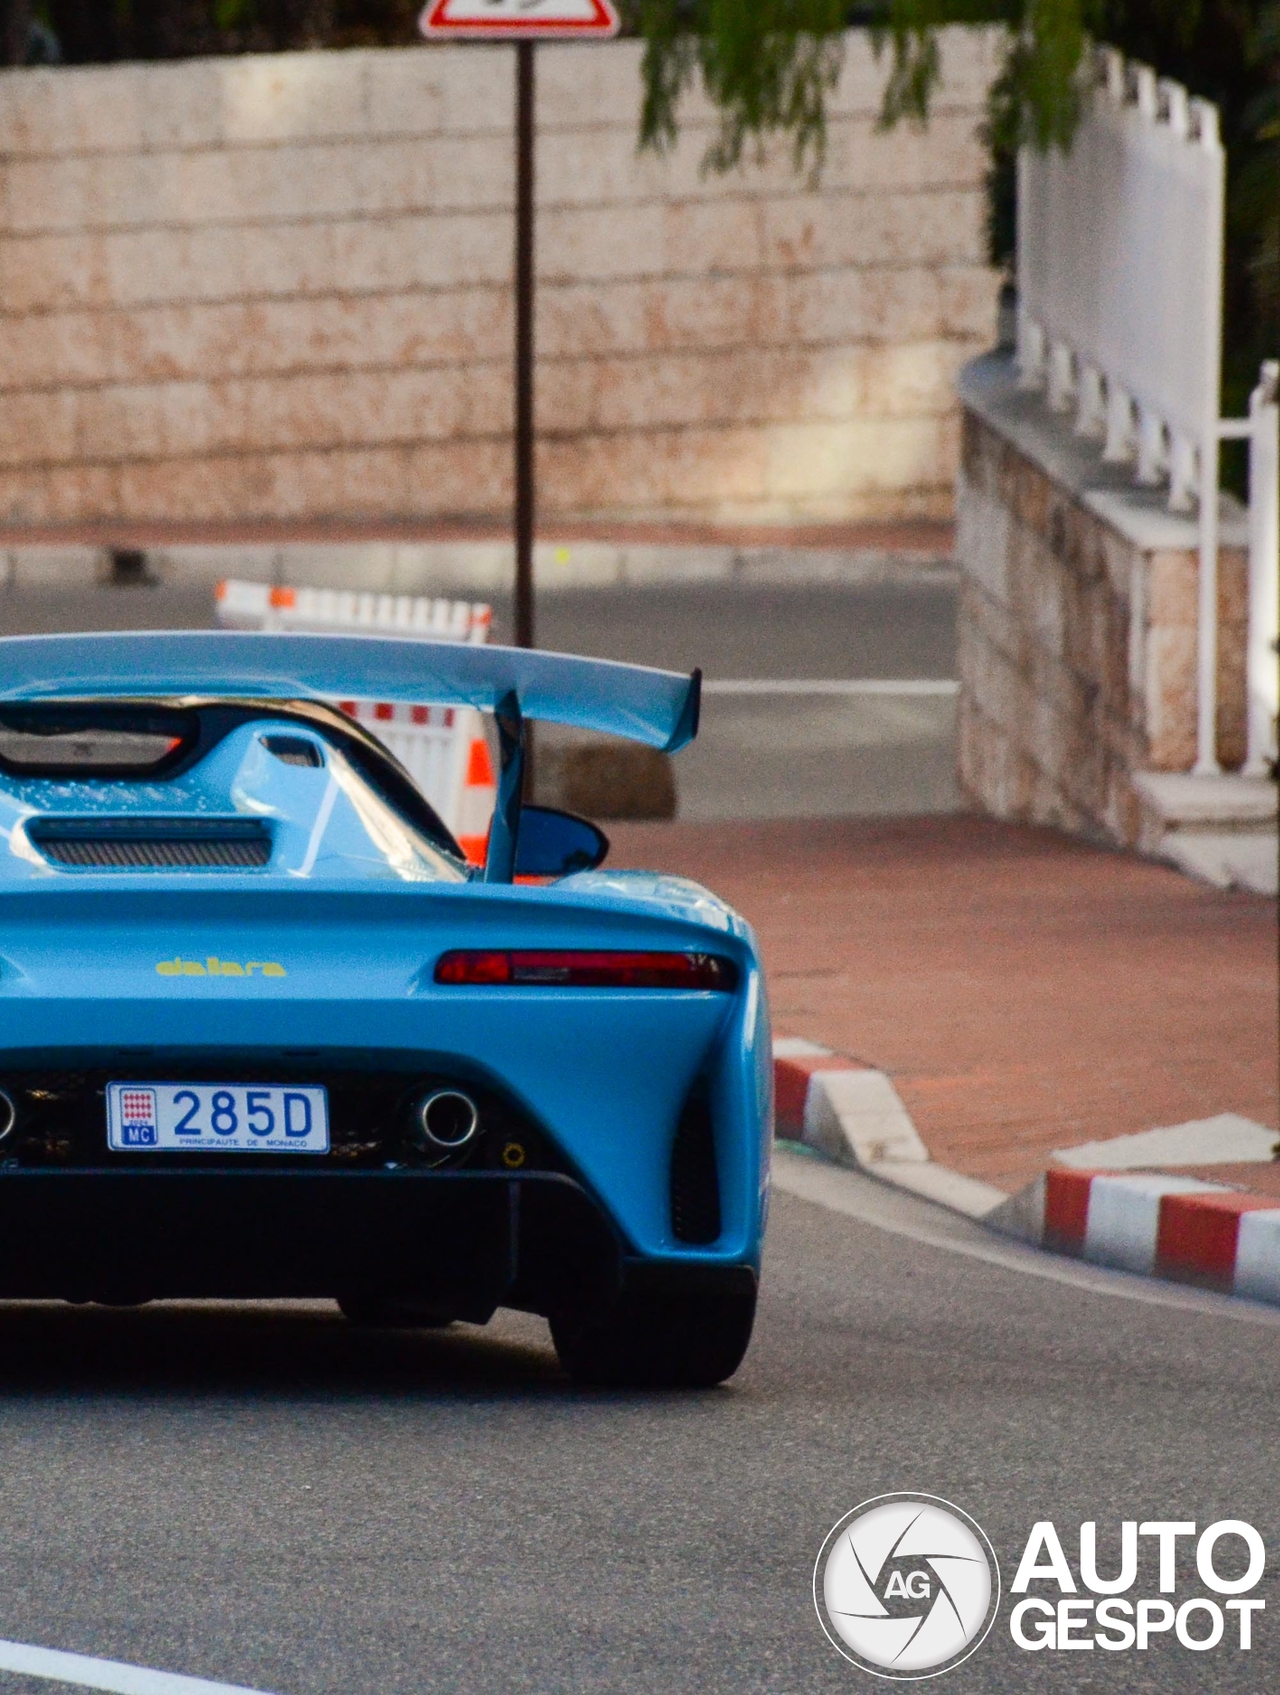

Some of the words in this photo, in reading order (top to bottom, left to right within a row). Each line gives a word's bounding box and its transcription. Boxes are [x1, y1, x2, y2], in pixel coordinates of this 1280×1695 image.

[172, 1090, 312, 1138] 285D
[128, 1127, 150, 1143] MC
[247, 1139, 259, 1147] DE
[266, 1140, 308, 1148] MONACO
